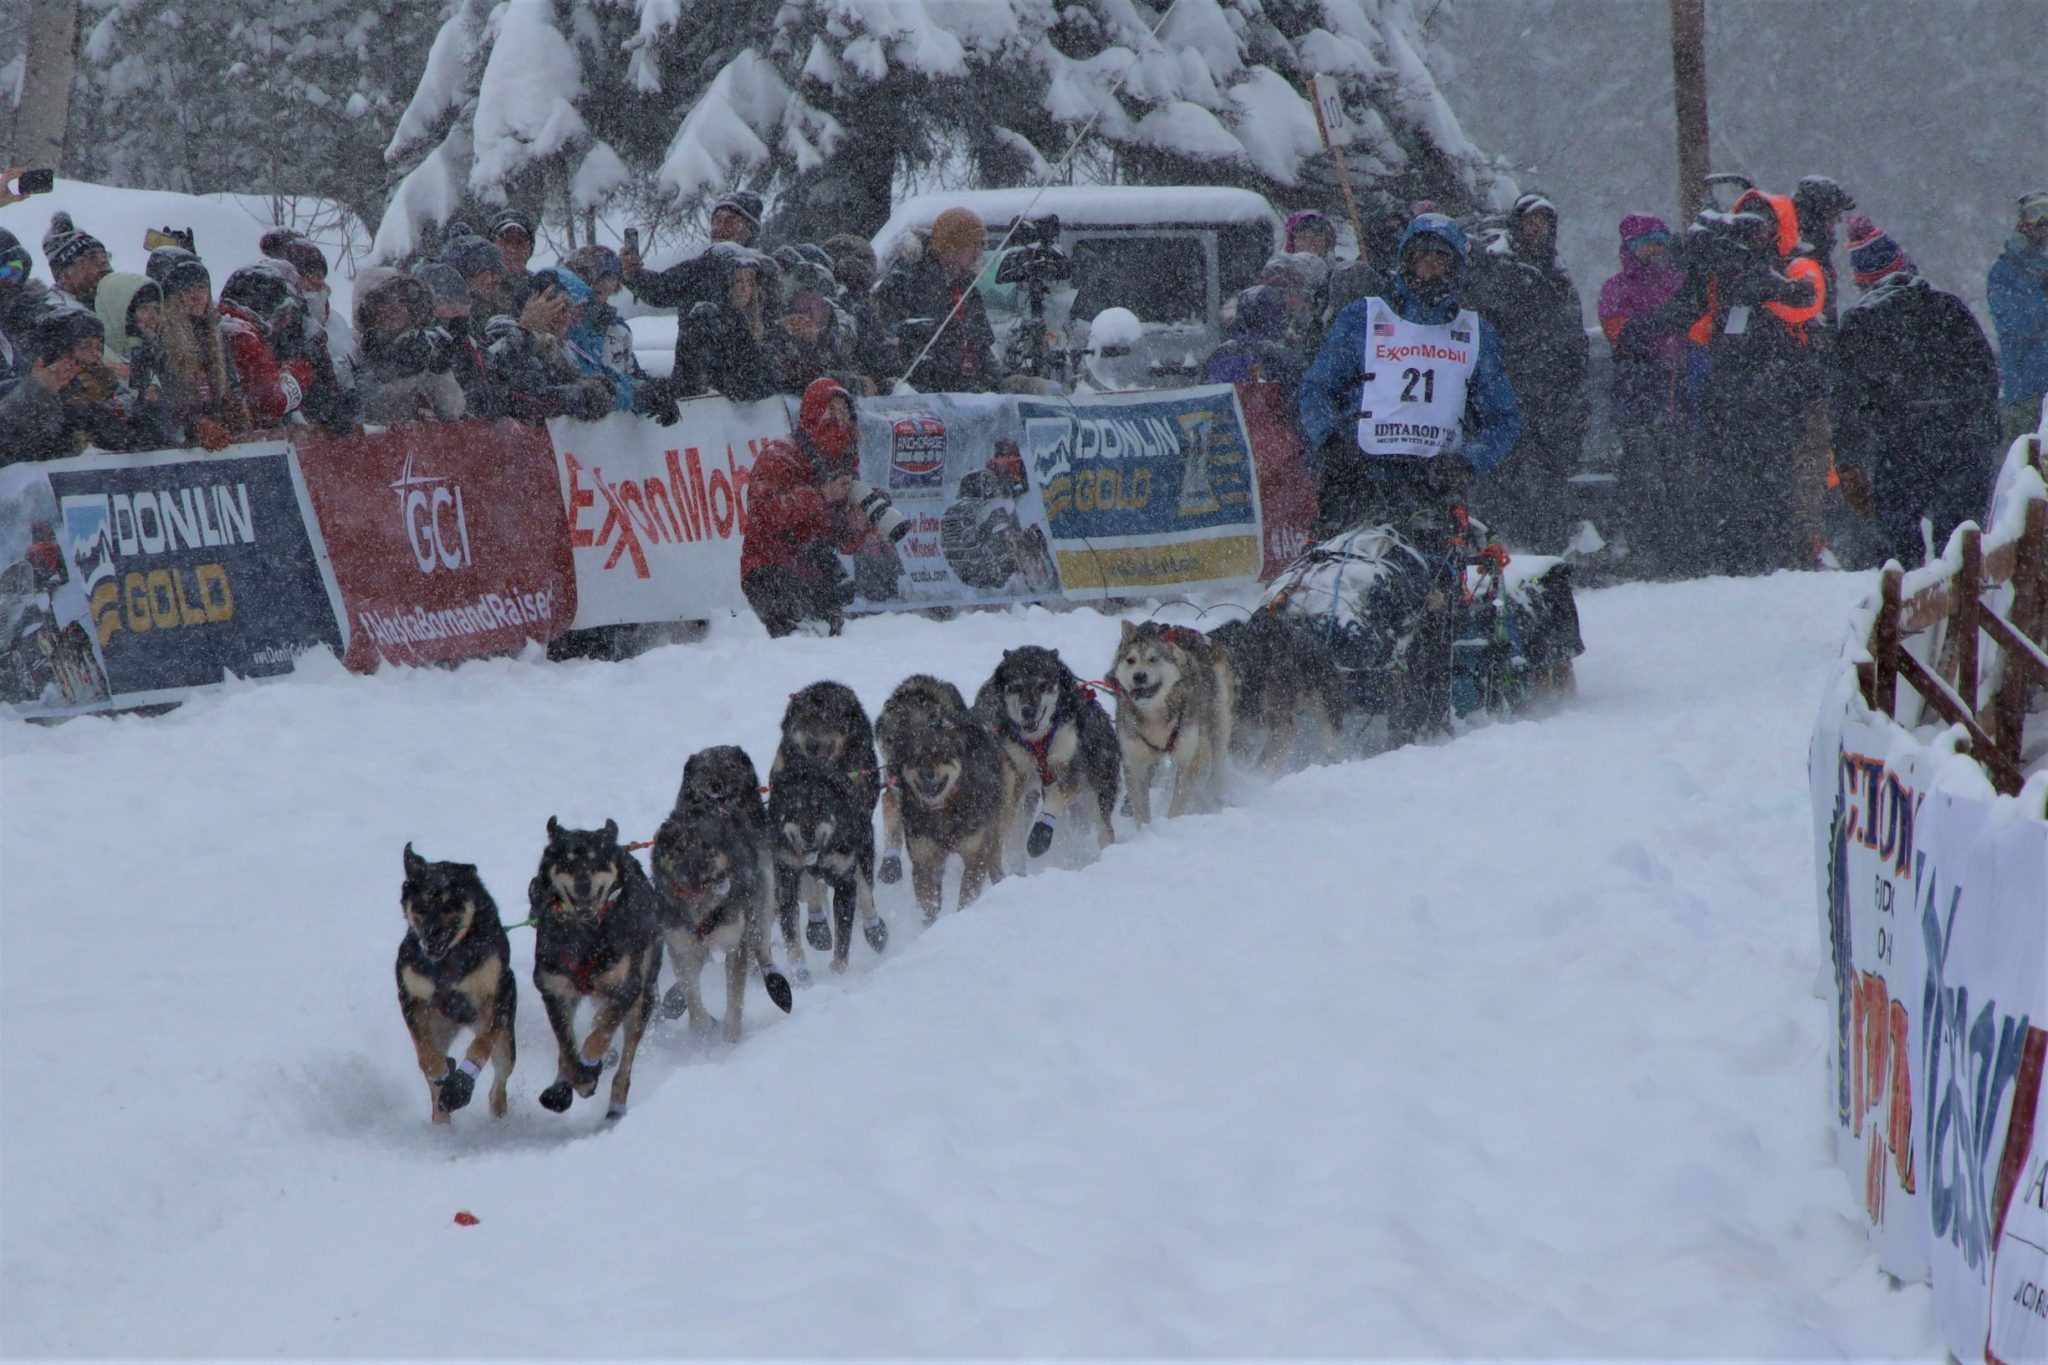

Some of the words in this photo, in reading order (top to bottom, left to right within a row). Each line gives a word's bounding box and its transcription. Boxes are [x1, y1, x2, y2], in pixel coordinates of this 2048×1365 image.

[1323, 96, 1343, 129] 10
[1376, 344, 1467, 364] ExxonMobil
[1400, 367, 1435, 404] 21
[1075, 417, 1181, 459] DONLIN
[1375, 423, 1440, 439] IDITAROD
[564, 437, 772, 579] ExxonMob
[1075, 467, 1152, 512] GOLD
[112, 483, 255, 556] DONLIN
[406, 485, 473, 574] GCI
[125, 563, 235, 633] GOLD
[358, 586, 552, 650] #AlaskaBornandRaise
